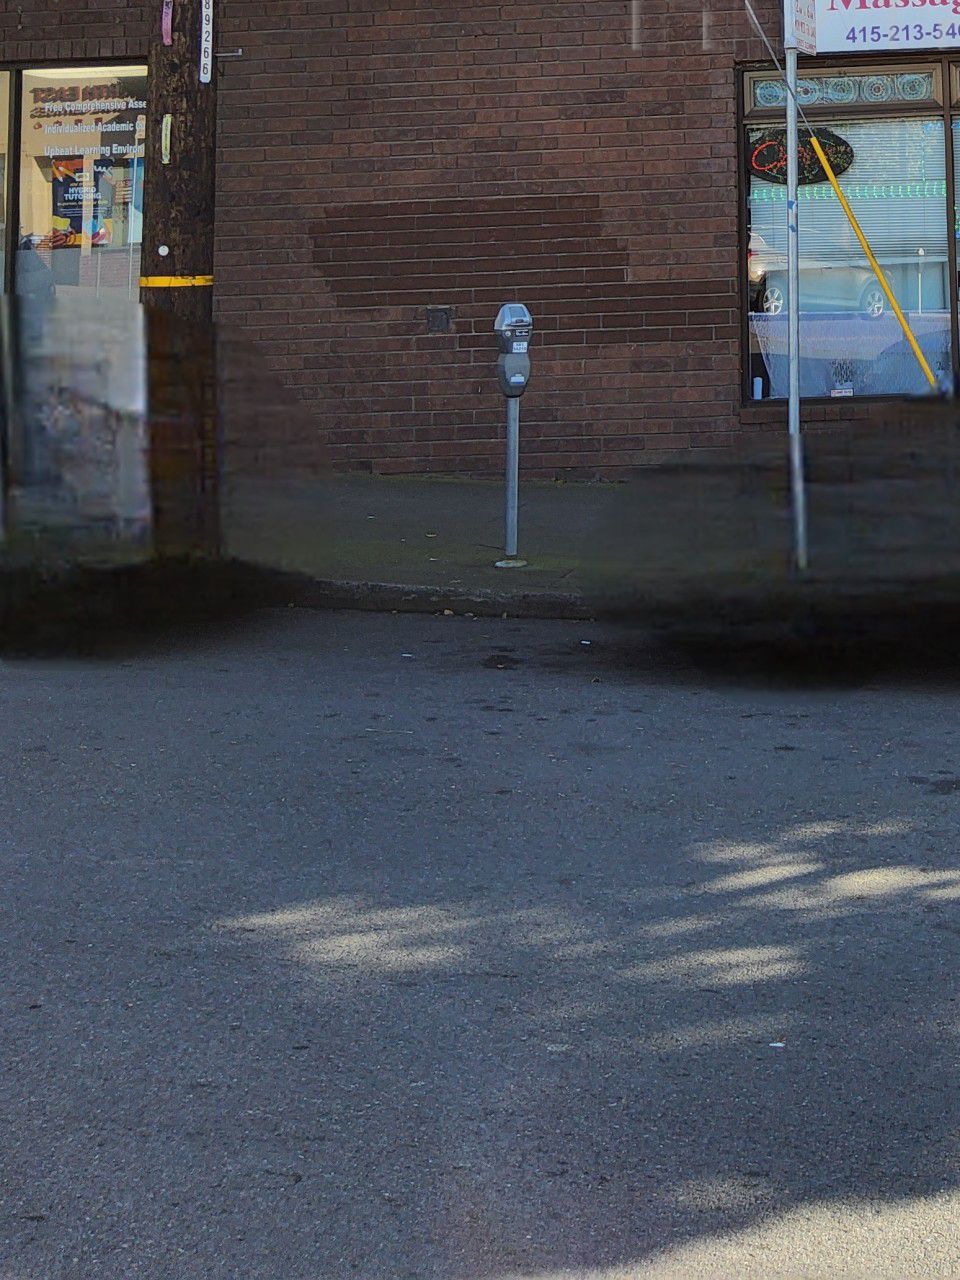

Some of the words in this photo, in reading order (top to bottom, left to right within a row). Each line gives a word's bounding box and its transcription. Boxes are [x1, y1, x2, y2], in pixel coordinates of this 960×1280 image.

[44, 102, 63, 113] Free
[65, 100, 127, 113] Comprehensive
[44, 122, 96, 135] Individualized
[97, 121, 134, 132] Academic
[44, 146, 73, 158] Upbeat
[75, 144, 111, 157] Learning
